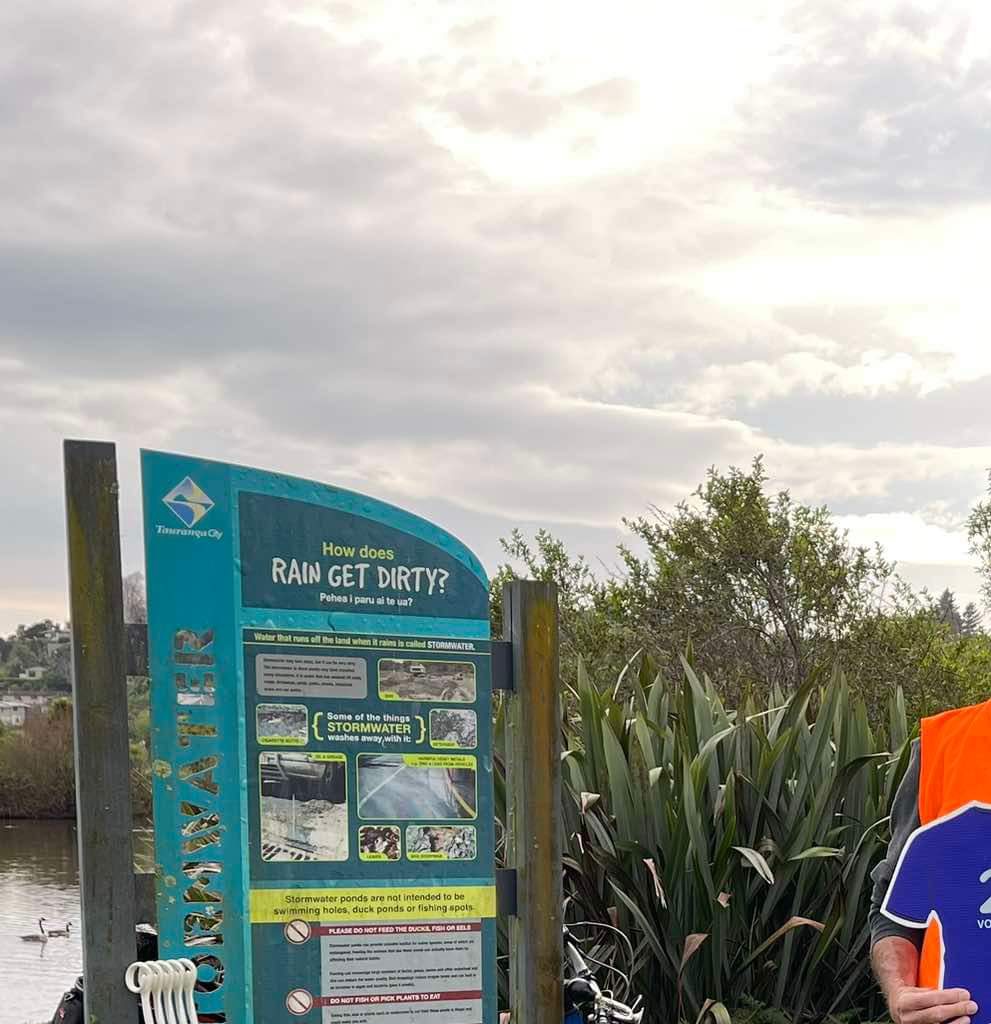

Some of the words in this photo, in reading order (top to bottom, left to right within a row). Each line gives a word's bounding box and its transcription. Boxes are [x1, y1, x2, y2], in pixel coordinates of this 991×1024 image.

[322, 541, 355, 558] How
[359, 545, 395, 560] does
[272, 557, 321, 585] RAIN
[328, 563, 370, 589] GET
[377, 566, 450, 595] DIRTY?
[320, 592, 348, 603] Pehea
[354, 595, 375, 605] paru
[376, 596, 385, 605] ai
[386, 596, 395, 606] te
[396, 597, 413, 607] ua?
[254, 632, 275, 641] Water
[277, 633, 292, 641] that
[293, 635, 309, 643] runs
[310, 635, 321, 643] off
[322, 636, 334, 644] the
[335, 635, 351, 644] land
[351, 637, 371, 646] when
[372, 638, 378, 646] it
[379, 639, 397, 647] rains
[398, 639, 404, 647] is
[406, 640, 426, 648] called
[327, 712, 352, 721] Some
[355, 713, 364, 721] of
[366, 713, 380, 722] the
[383, 714, 410, 723] things
[327, 722, 411, 734] STORMWATER
[328, 734, 359, 742] washes
[361, 735, 383, 744] away
[383, 735, 401, 743] with
[285, 895, 337, 904] Stormwater
[340, 894, 368, 904] ponds
[387, 894, 401, 902] not
[403, 893, 441, 901] intended
[273, 906, 320, 916] swimming
[352, 905, 374, 913] duck
[376, 904, 404, 914] ponds
[418, 904, 448, 913] fishing
[355, 996, 370, 1004] FISH
[370, 995, 380, 1003] OR
[396, 994, 420, 1002] PLANTS
